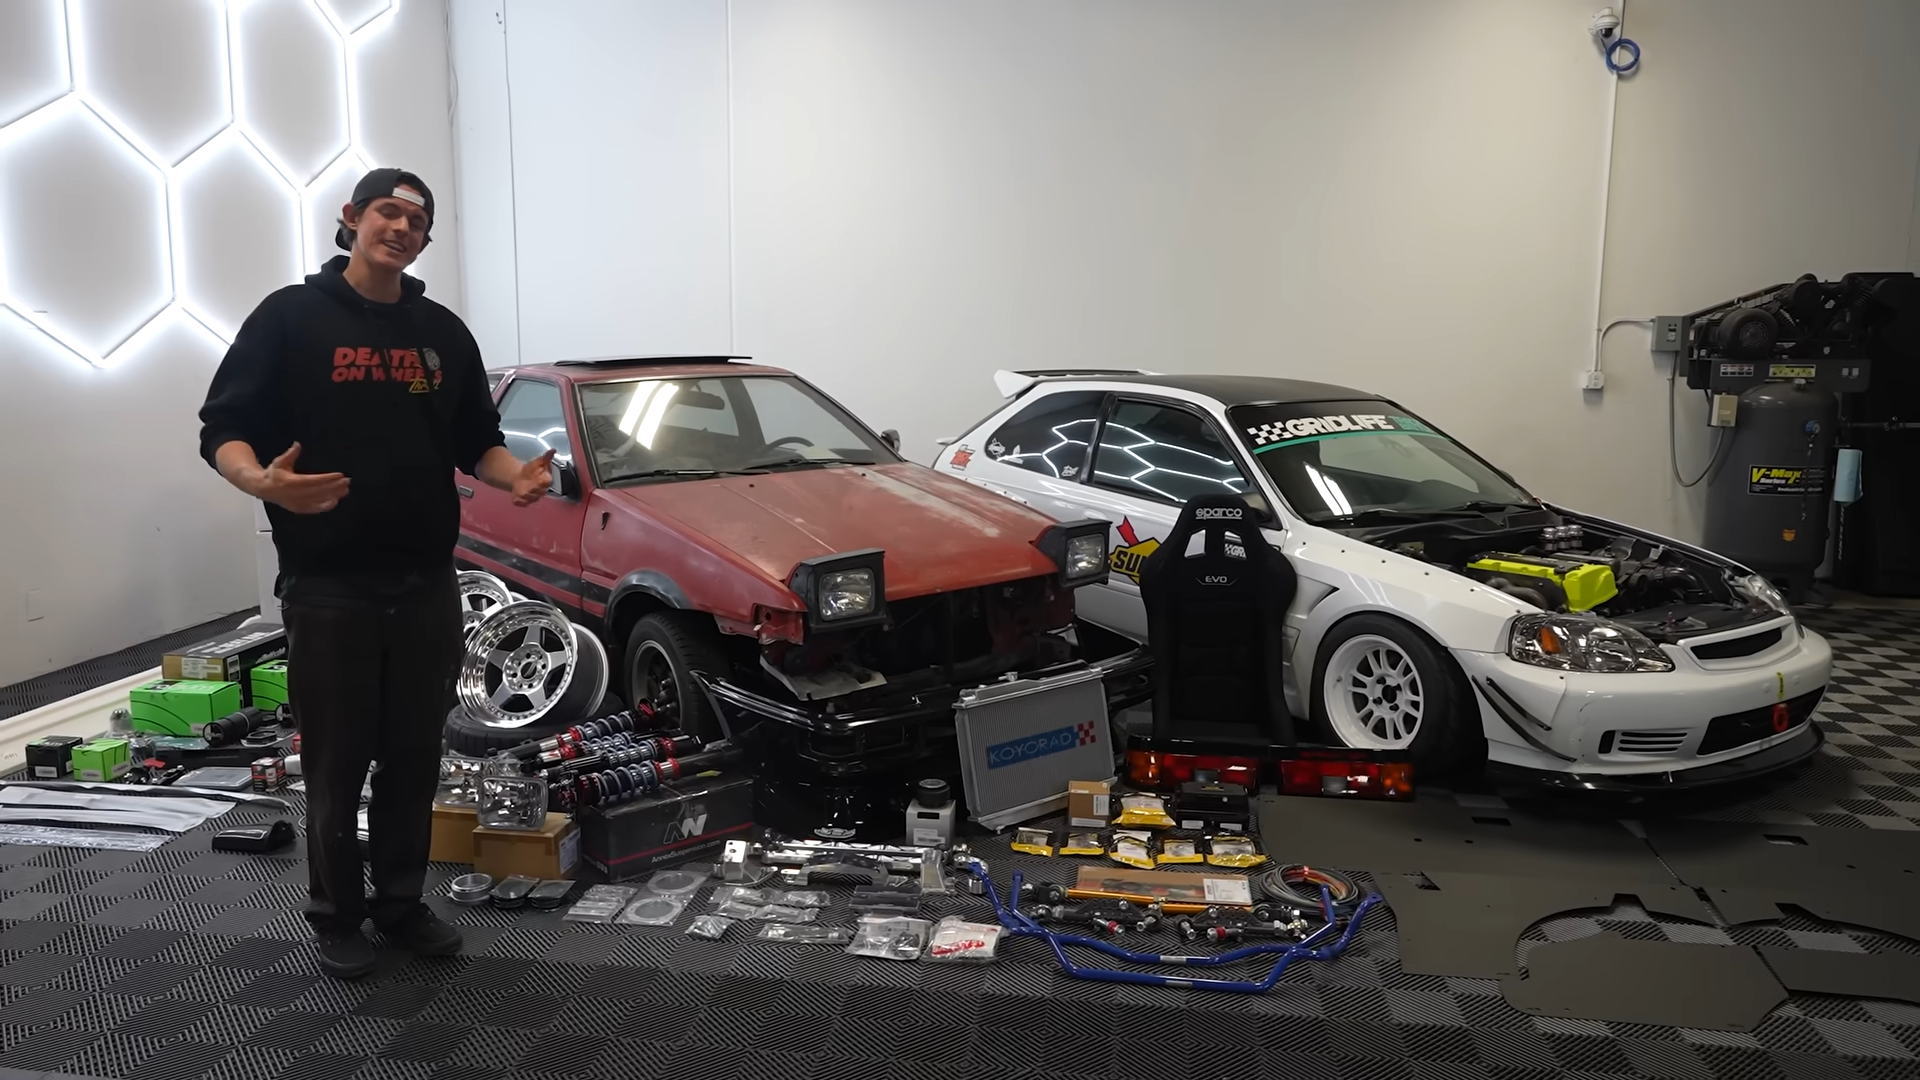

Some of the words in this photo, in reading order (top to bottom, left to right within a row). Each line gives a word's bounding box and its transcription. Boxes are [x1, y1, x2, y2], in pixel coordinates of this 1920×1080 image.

[331, 366, 366, 383] ON
[1285, 414, 1395, 436] GRIDLIFE
[1752, 468, 1803, 484] V-Max
[1195, 507, 1243, 520] sparco
[989, 732, 1072, 764] KOYORAD
[651, 840, 721, 863] AnnexSuspension.com
